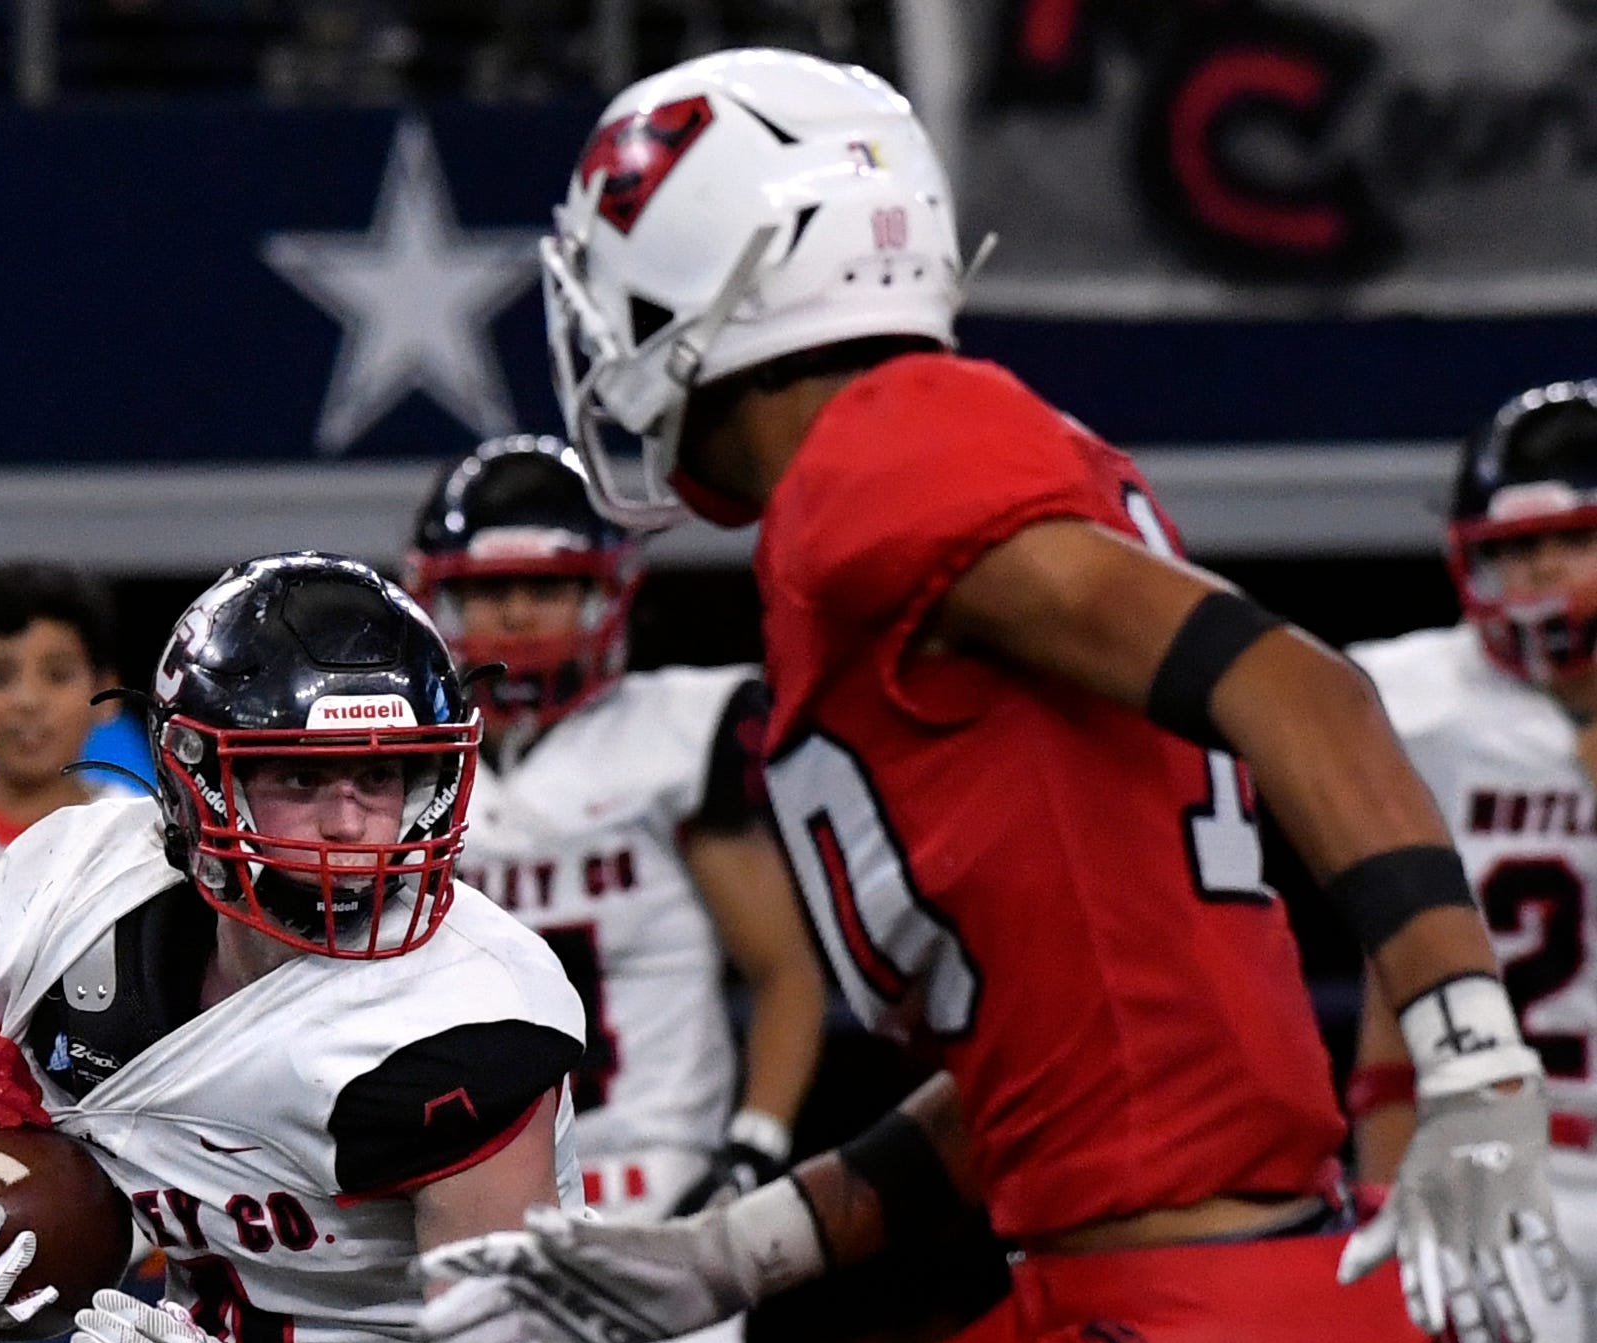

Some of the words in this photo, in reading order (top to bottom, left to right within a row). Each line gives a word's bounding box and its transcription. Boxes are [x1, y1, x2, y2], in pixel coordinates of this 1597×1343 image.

[323, 701, 404, 720] Riddell
[316, 901, 359, 912] Rddell
[225, 1191, 336, 1253] CO.
